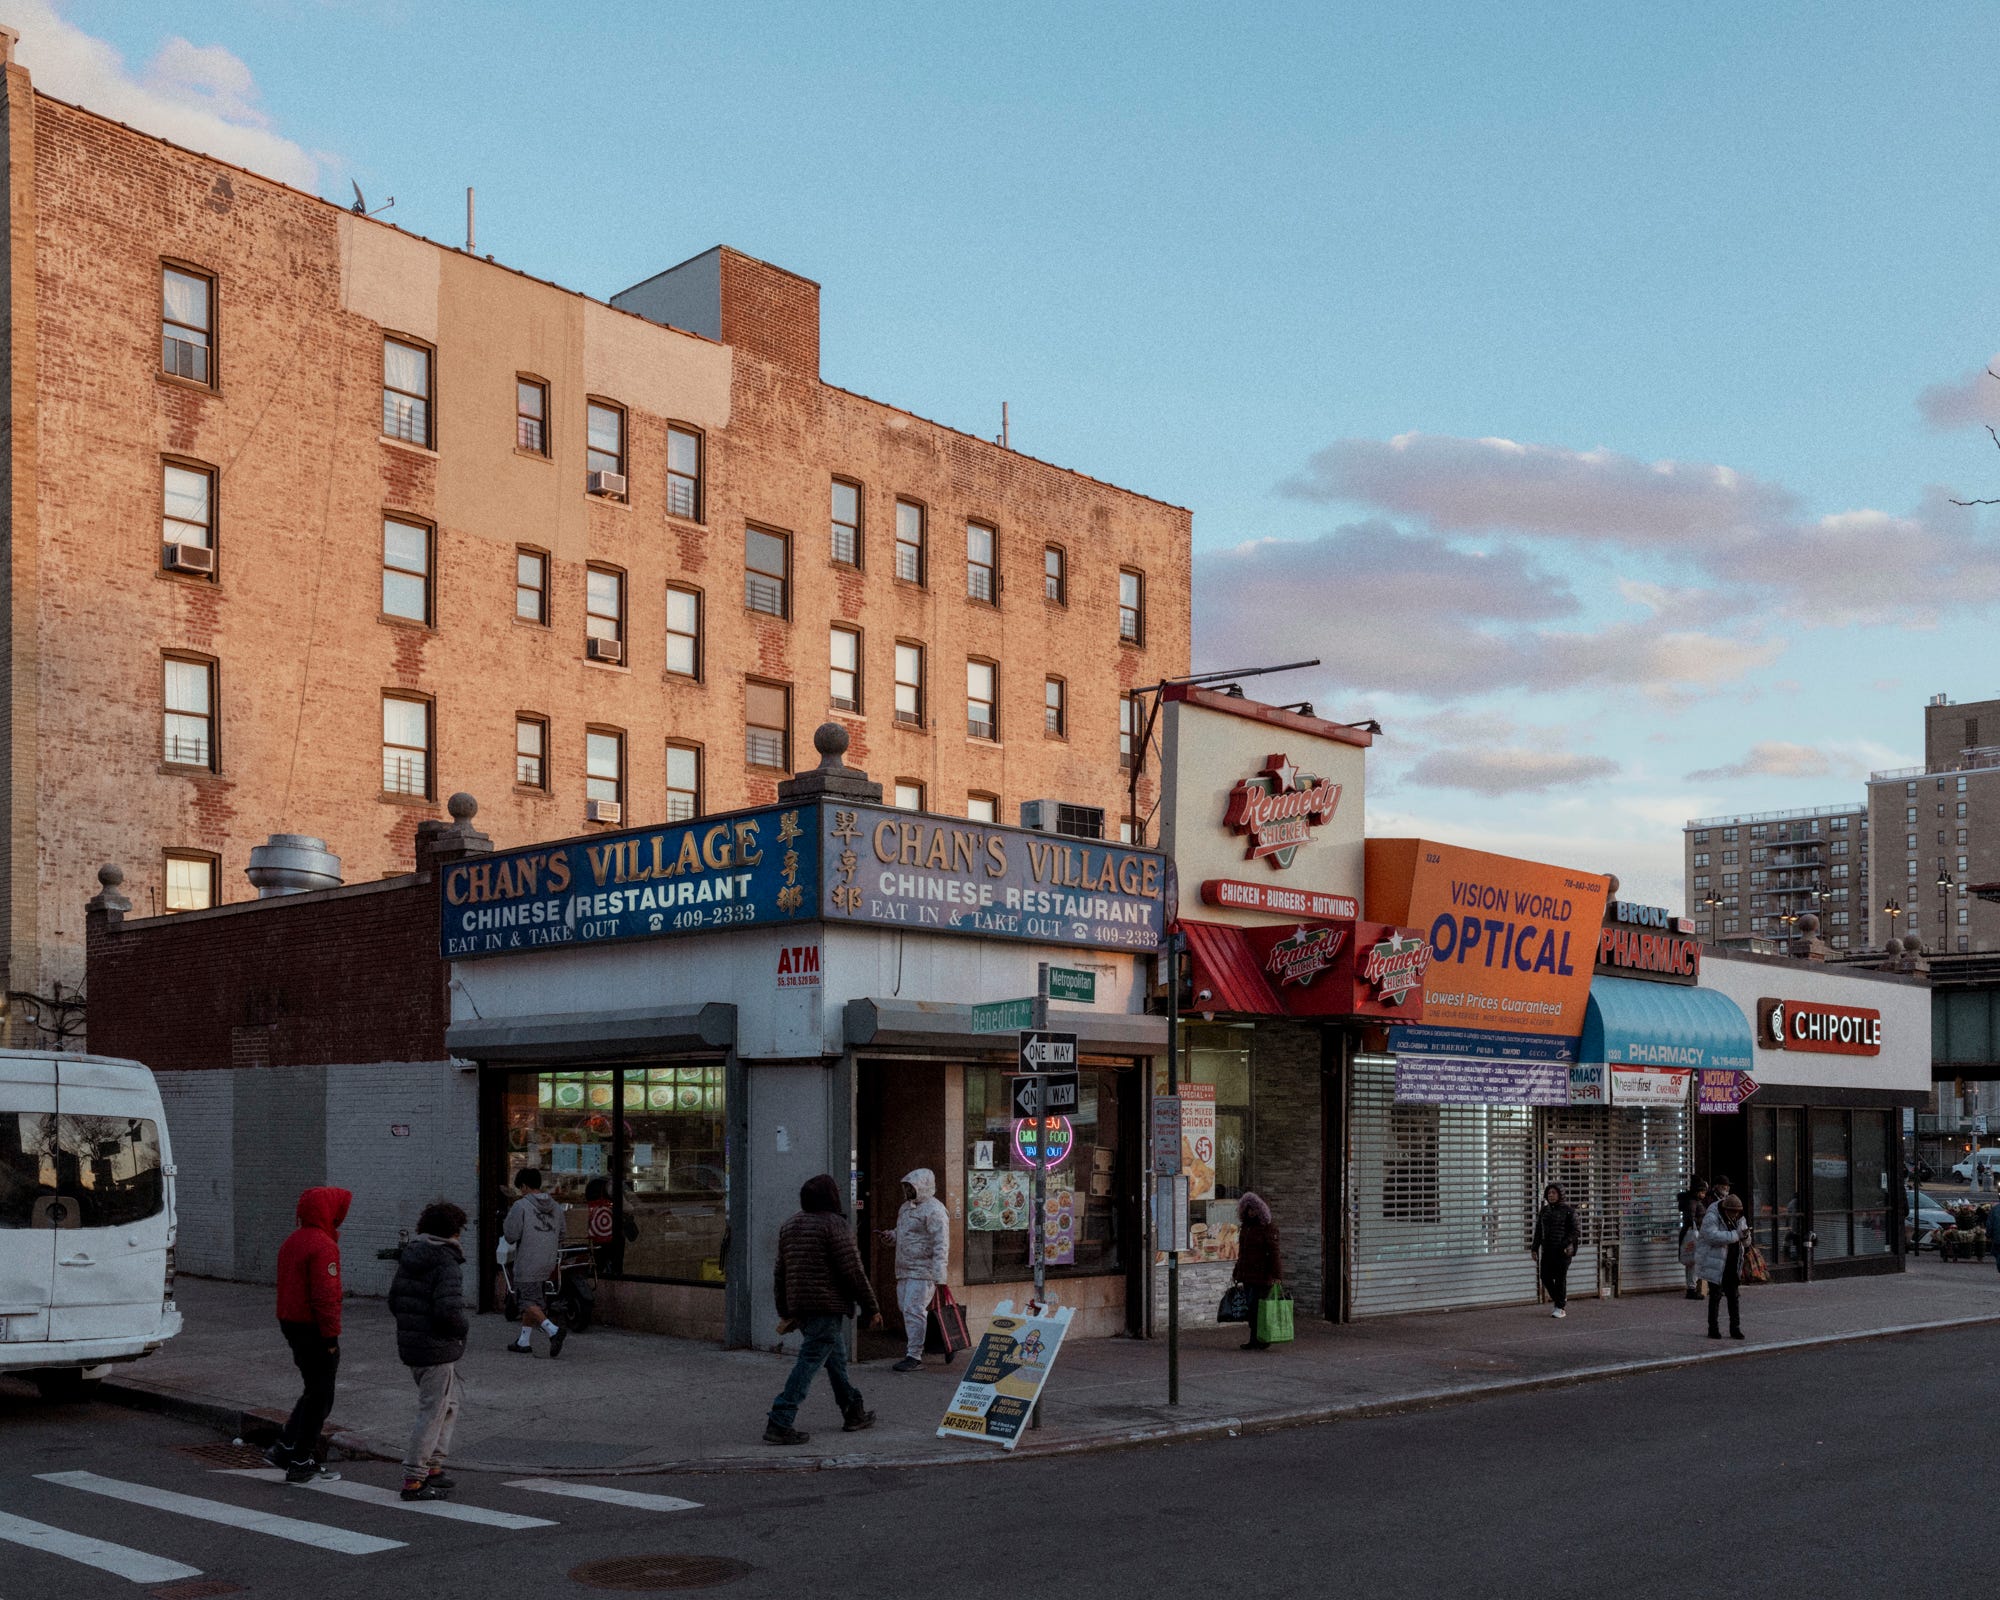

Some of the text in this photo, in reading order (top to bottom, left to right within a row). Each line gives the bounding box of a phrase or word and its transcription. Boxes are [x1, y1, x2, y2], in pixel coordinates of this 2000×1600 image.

[1240, 777, 1342, 833] Kennedy
[1258, 819, 1311, 847] CHICKEN
[446, 819, 763, 906] CHAN'S VILLAGE
[873, 819, 1159, 899] CHAN'S VILLAGE
[462, 873, 753, 932] CHINESE RESTAURANT
[879, 871, 1152, 926] CHINESE RESTAURANT
[1221, 882, 1355, 917] CHICKEN BURGERS HOTWINGS
[1451, 880, 1572, 922] VISION WORLD
[871, 898, 909, 921] EAT
[919, 904, 940, 924] IN
[949, 910, 963, 927] &
[972, 911, 1018, 933] TAKE
[1027, 918, 1063, 938] OUT
[1094, 925, 1159, 948] 409-2333
[1616, 901, 1670, 929] BRONX
[448, 903, 756, 954] EAT IN & TAKE OUT 409-2333
[1267, 929, 1349, 973] Kennedy
[1429, 913, 1574, 977] OPTICAL
[1600, 927, 1704, 977] PHARMACY
[777, 945, 820, 975] ATM
[1285, 956, 1325, 978] CHICKEN
[1365, 942, 1434, 985] Kennedy
[1051, 969, 1092, 990] Metropolitan
[1382, 972, 1417, 991] CHICKEN
[1425, 989, 1562, 1016] Lowest Prices Guaranteed
[973, 1003, 1018, 1033] Benedict
[1442, 1010, 1456, 1018] HOUR
[1458, 1011, 1479, 1020] SERVICE
[1795, 1011, 1881, 1046] CHIPOTLE
[1029, 1044, 1071, 1061] ONE WAY
[1629, 1043, 1705, 1065] PHARMACY
[1570, 1067, 1602, 1083] RMACY
[1619, 1075, 1652, 1092] healthfirst
[1670, 1075, 1683, 1086] CVS
[1704, 1071, 1736, 1086] NOTARY
[1023, 1085, 1072, 1106] ON WAY
[1180, 1091, 1204, 1099] SPECIAL
[1193, 1084, 1214, 1092] CHICKEN
[1706, 1086, 1733, 1102] PUBLIC
[1194, 1107, 1213, 1116] MIXED
[1700, 1102, 1739, 1112] AVAILABLE HERE
[1182, 1117, 1213, 1128] CHICKEN
[1049, 1131, 1070, 1144] FOOD
[979, 1144, 990, 1162] A
[1046, 1146, 1063, 1157] OUT
[1196, 1138, 1212, 1163] $5
[996, 1406, 1024, 1416] DELIVERY
